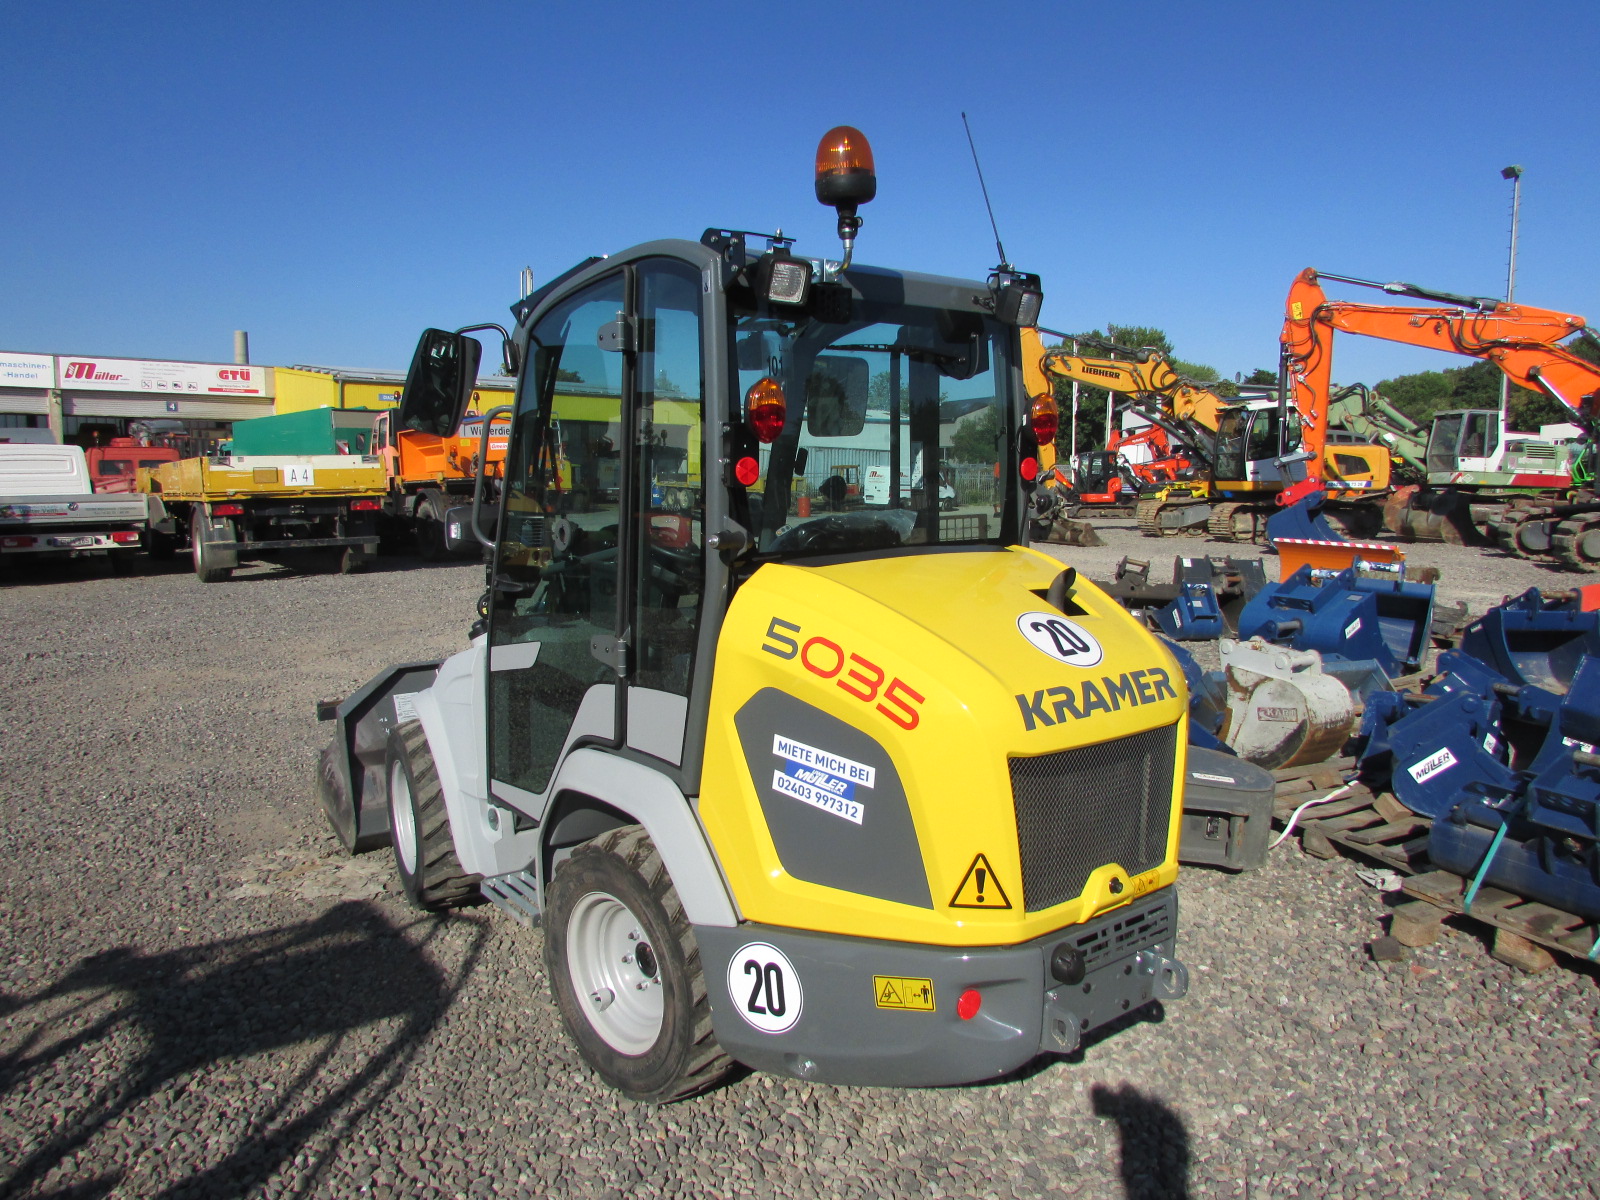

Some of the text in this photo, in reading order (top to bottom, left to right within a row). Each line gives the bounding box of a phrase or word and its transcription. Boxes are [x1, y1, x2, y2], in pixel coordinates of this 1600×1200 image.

[218, 368, 251, 381] GTÜ
[1082, 366, 1121, 379] LIEBHERR
[168, 403, 176, 411] 4
[291, 468, 309, 482] A 4
[1030, 619, 1091, 657] 20
[761, 616, 926, 731] 5035
[1014, 667, 1178, 731] KRAMER
[778, 741, 870, 782] MIETE MICH BEI
[777, 776, 858, 819] 02403 997312
[744, 959, 786, 1017] 20
